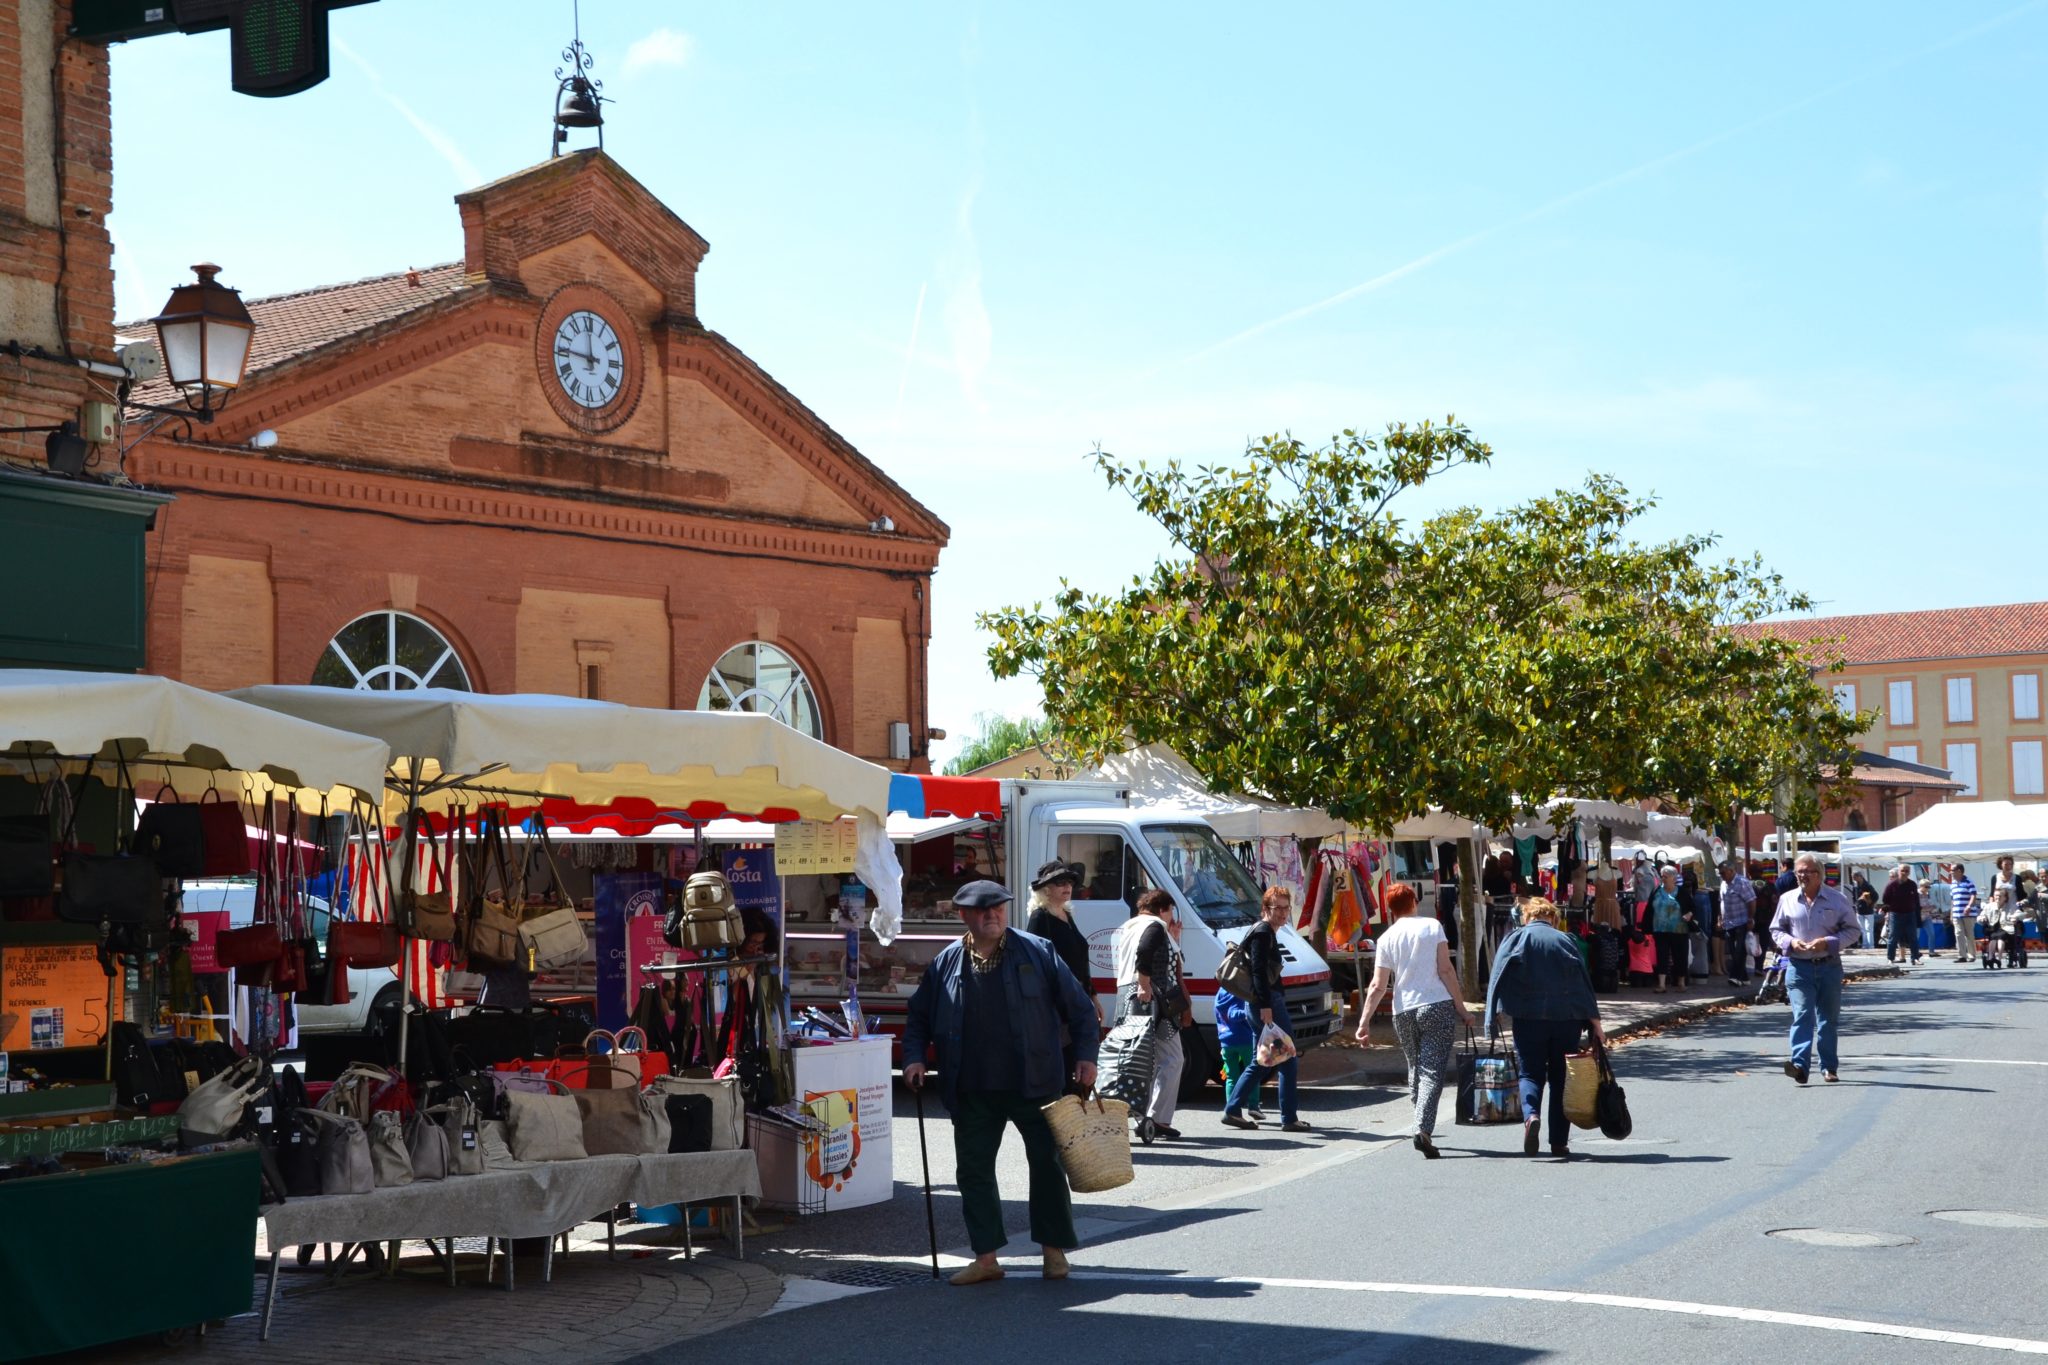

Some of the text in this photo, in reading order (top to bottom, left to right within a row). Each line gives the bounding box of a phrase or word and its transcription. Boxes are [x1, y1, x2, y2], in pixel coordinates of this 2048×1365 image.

[726, 868, 763, 883] Costa
[15, 971, 39, 980] POSE
[824, 1143, 848, 1153] cances
